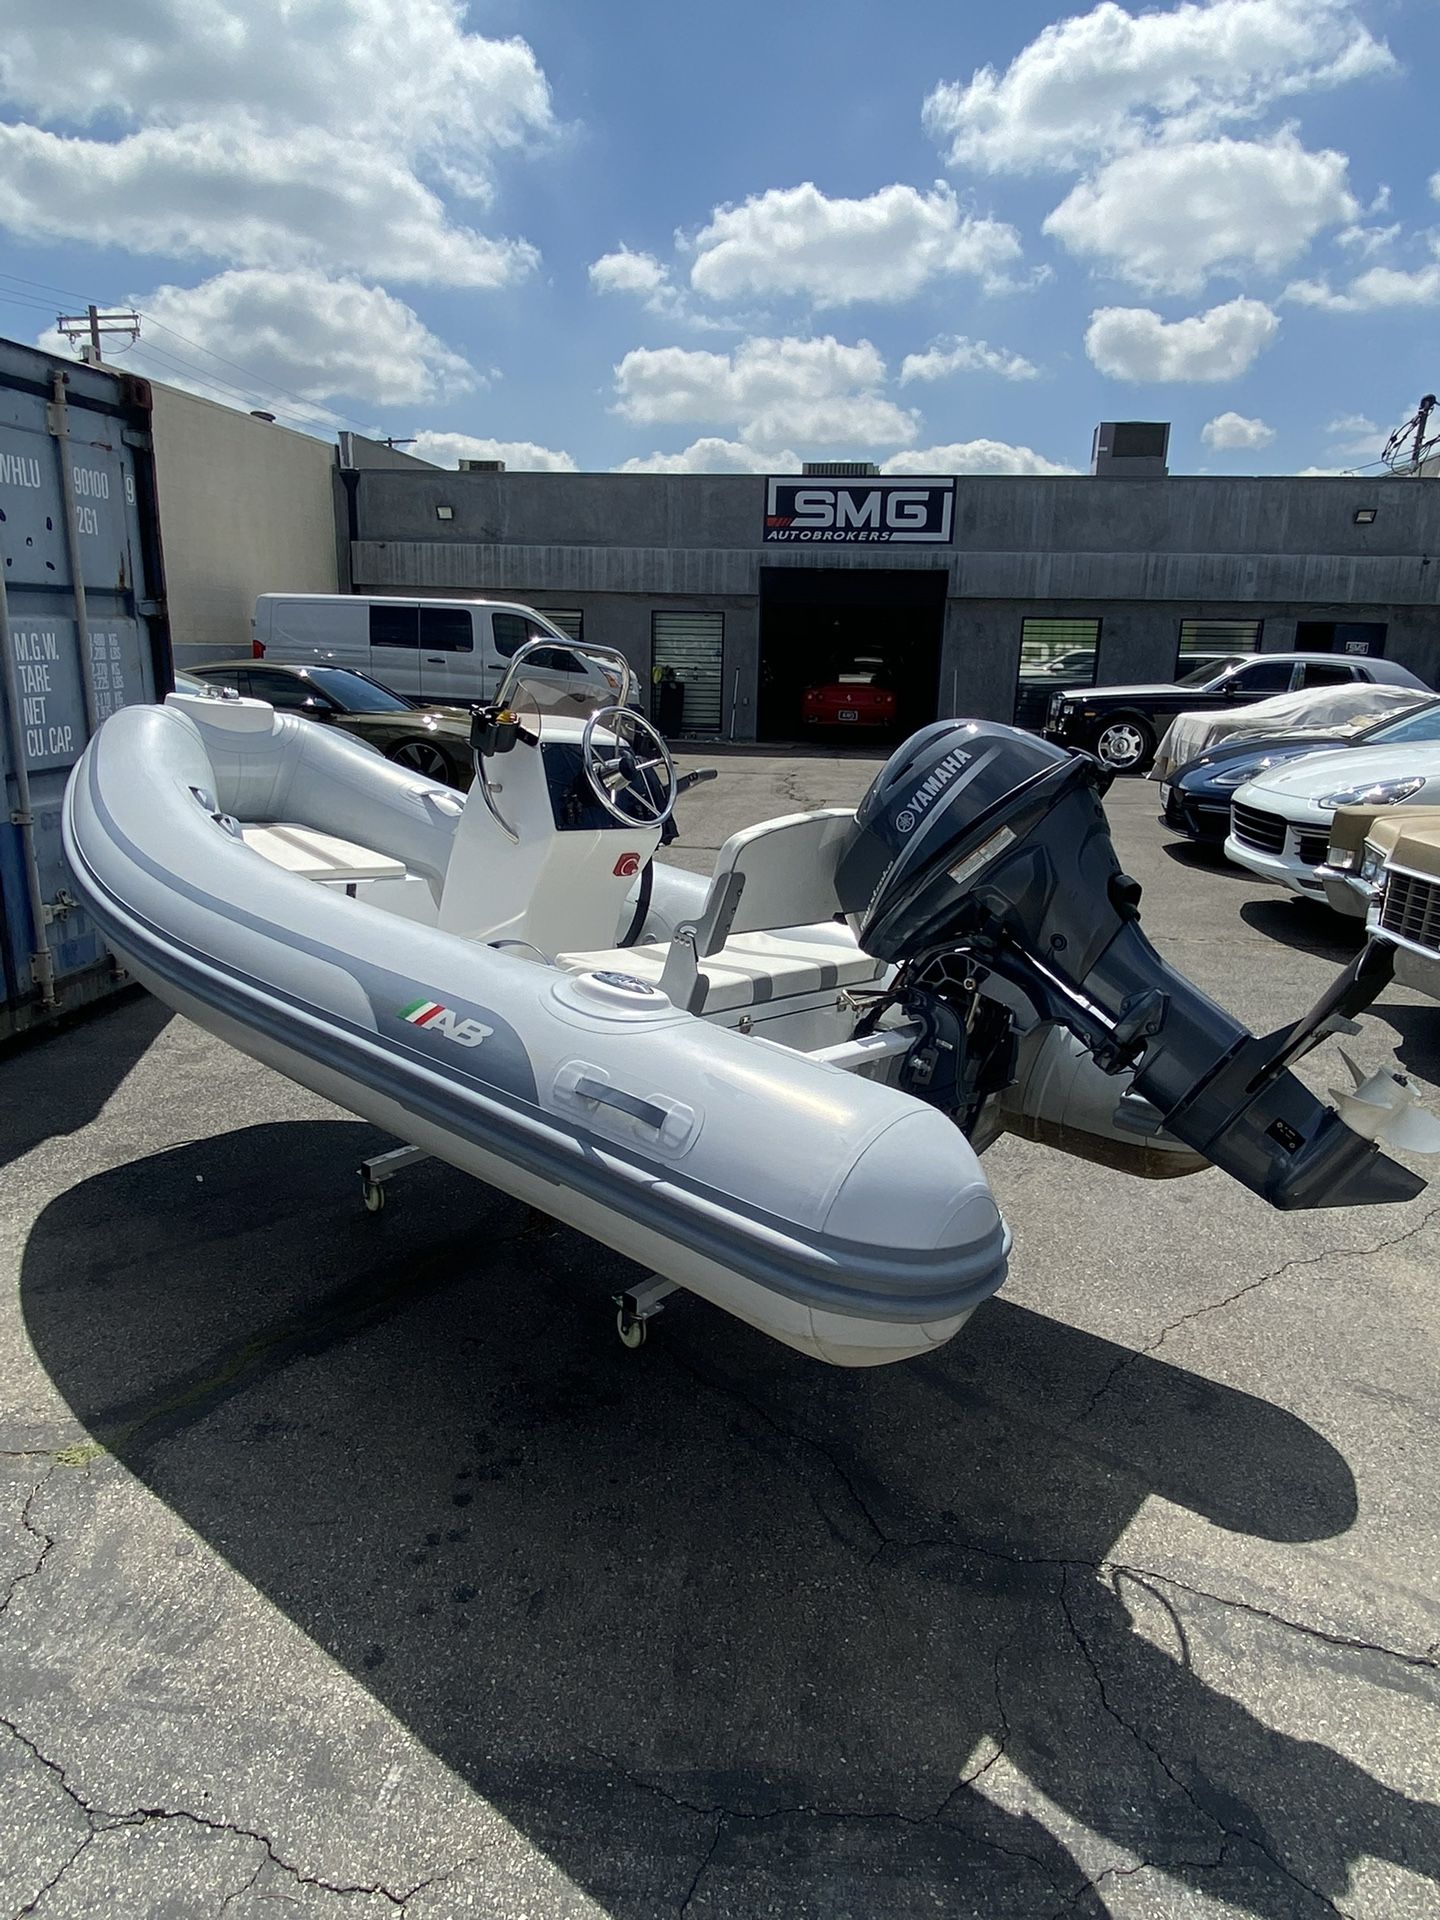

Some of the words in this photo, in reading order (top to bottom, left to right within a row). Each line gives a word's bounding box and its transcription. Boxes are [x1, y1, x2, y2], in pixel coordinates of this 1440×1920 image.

[73, 466, 109, 499] 90100
[126, 477, 135, 503] 9
[76, 506, 99, 536] 2G1
[790, 490, 929, 528] SMG
[767, 530, 890, 541] AUTOBROKERS
[14, 632, 59, 661] M.G.W.
[18, 665, 52, 693] TARE
[23, 697, 46, 725] NET
[27, 728, 48, 757] CU.
[49, 725, 74, 754] CAP.
[906, 748, 972, 813] YAMAHA
[421, 1008, 494, 1048] AB
